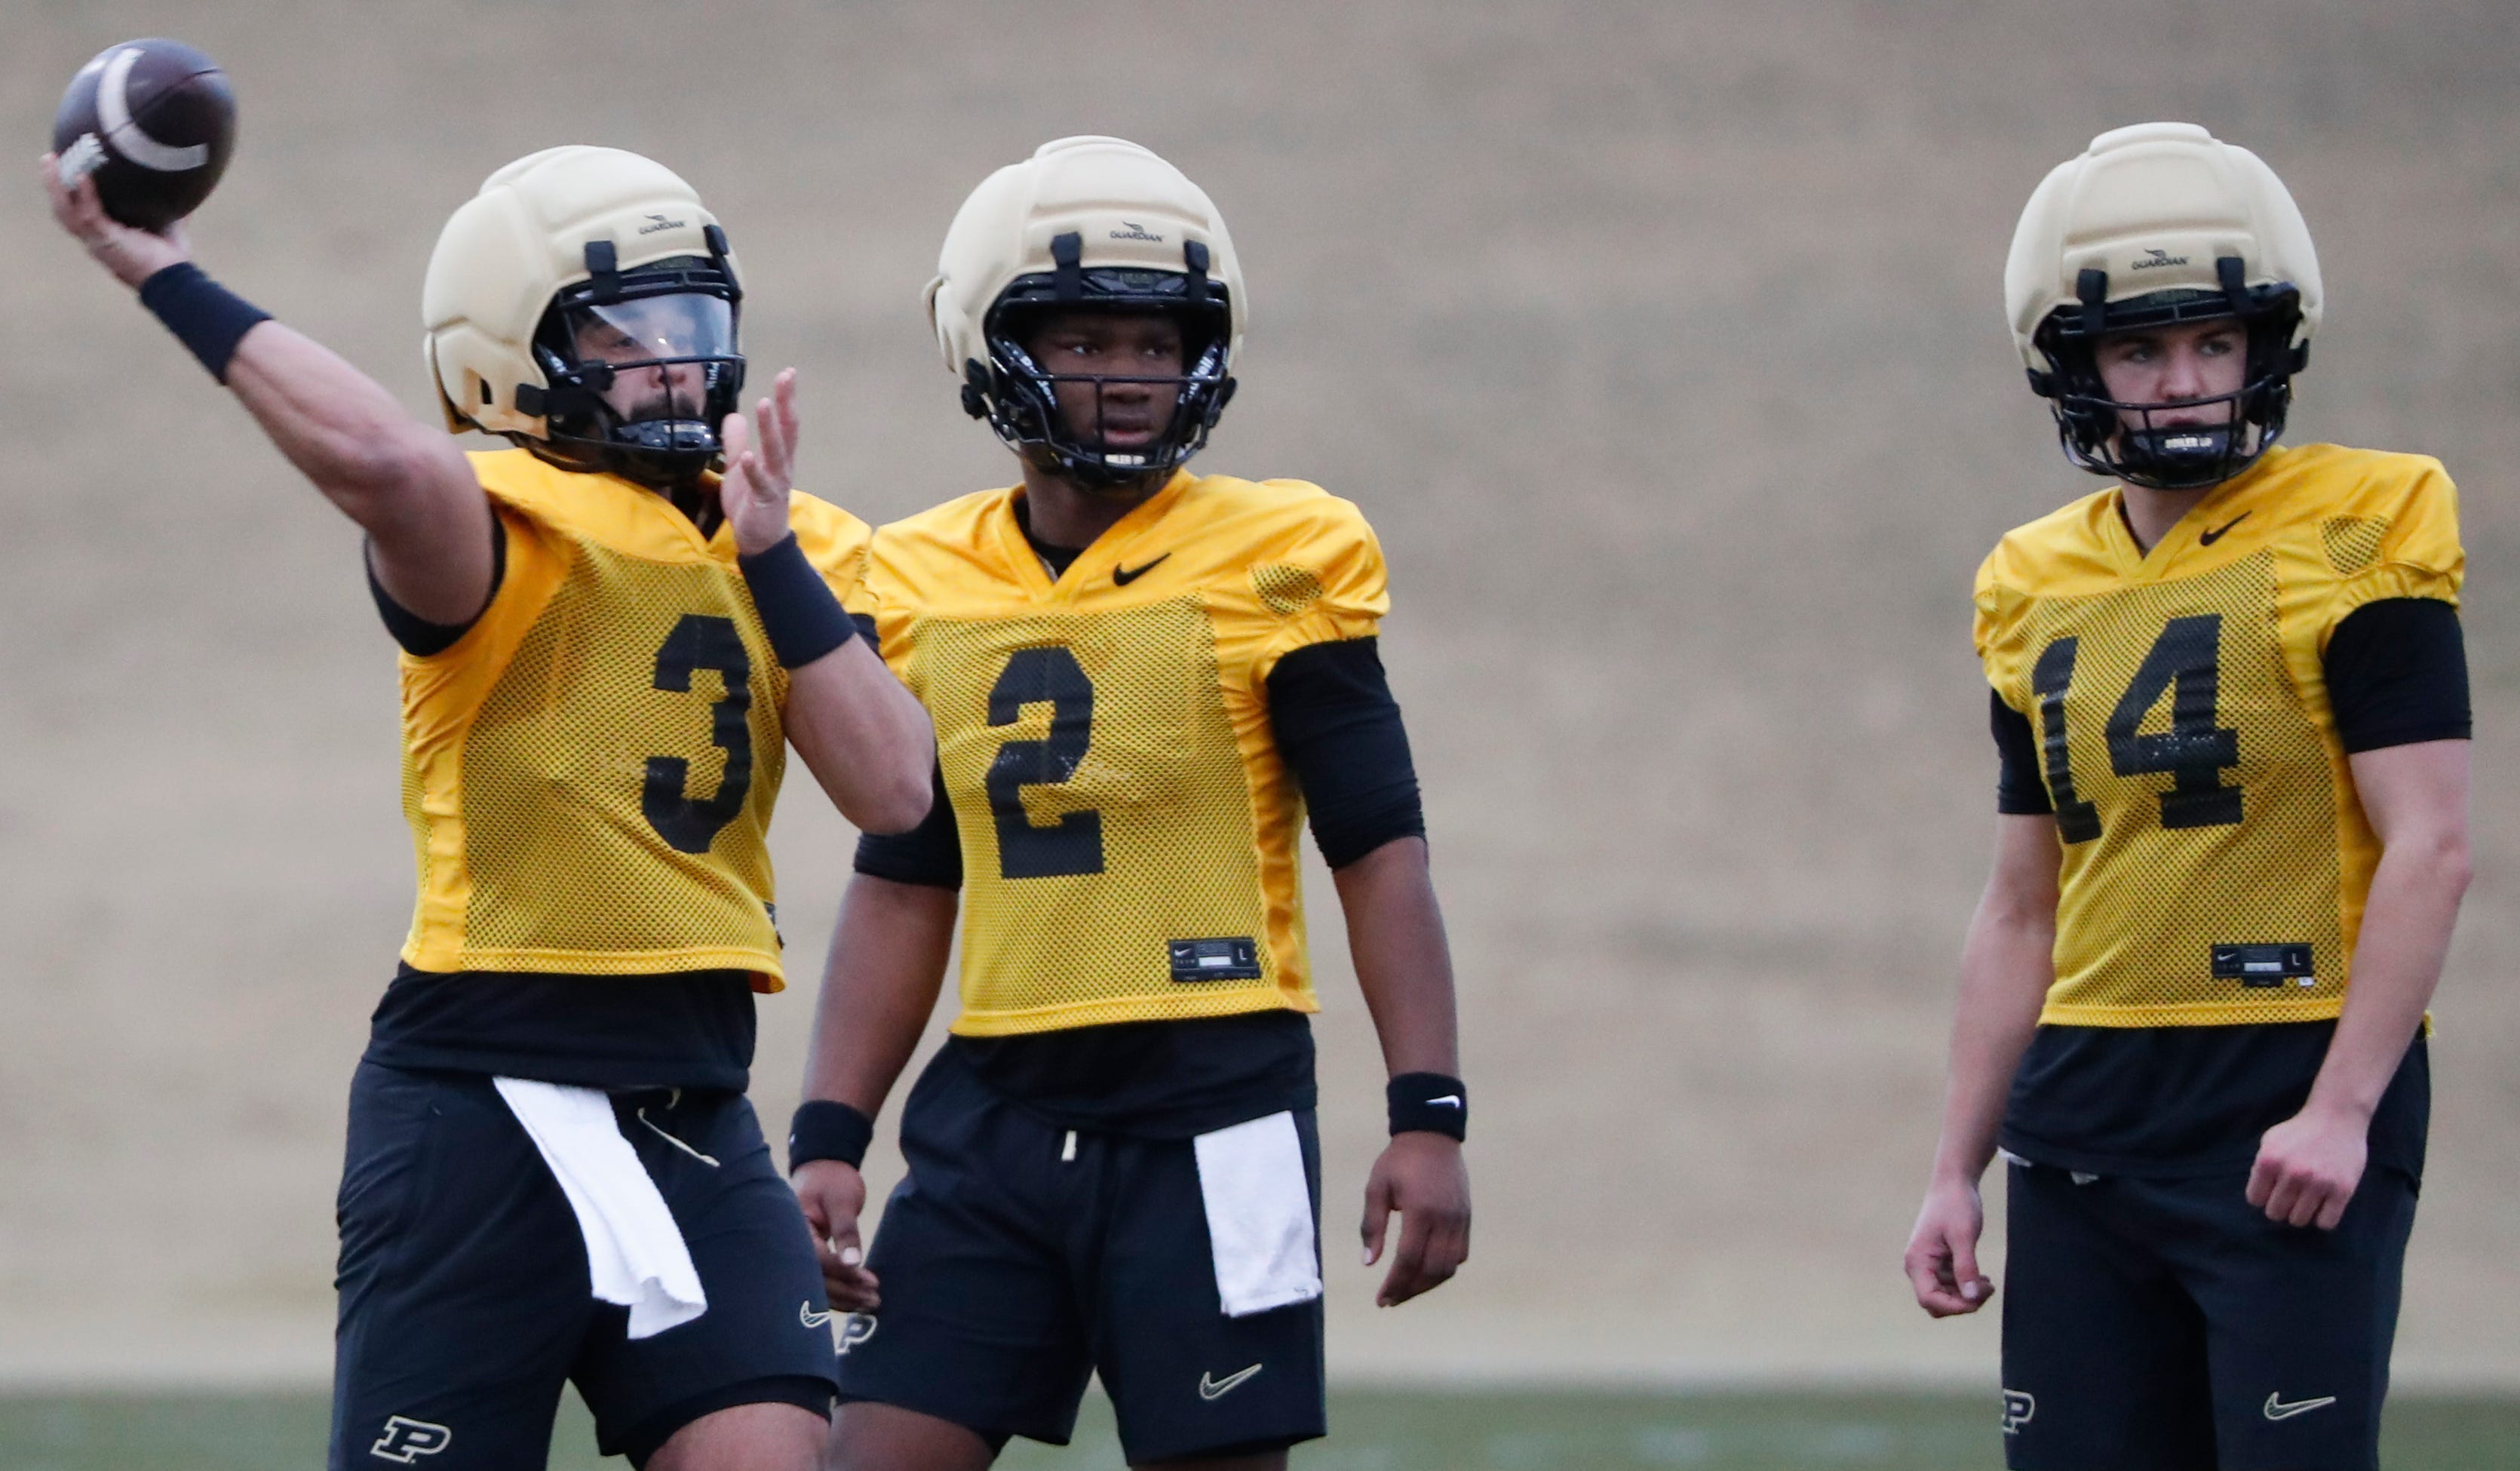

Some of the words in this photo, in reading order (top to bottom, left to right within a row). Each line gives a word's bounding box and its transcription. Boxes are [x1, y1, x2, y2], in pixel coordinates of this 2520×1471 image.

[1110, 231, 1163, 242] GUARDIAN
[2132, 256, 2190, 270] GUARDIAN
[641, 613, 751, 854] 3
[2031, 613, 2244, 845] 14
[986, 646, 1105, 879] 2
[1239, 947, 1248, 961] L
[2291, 953, 2301, 966] L
[370, 1415, 452, 1463] P
